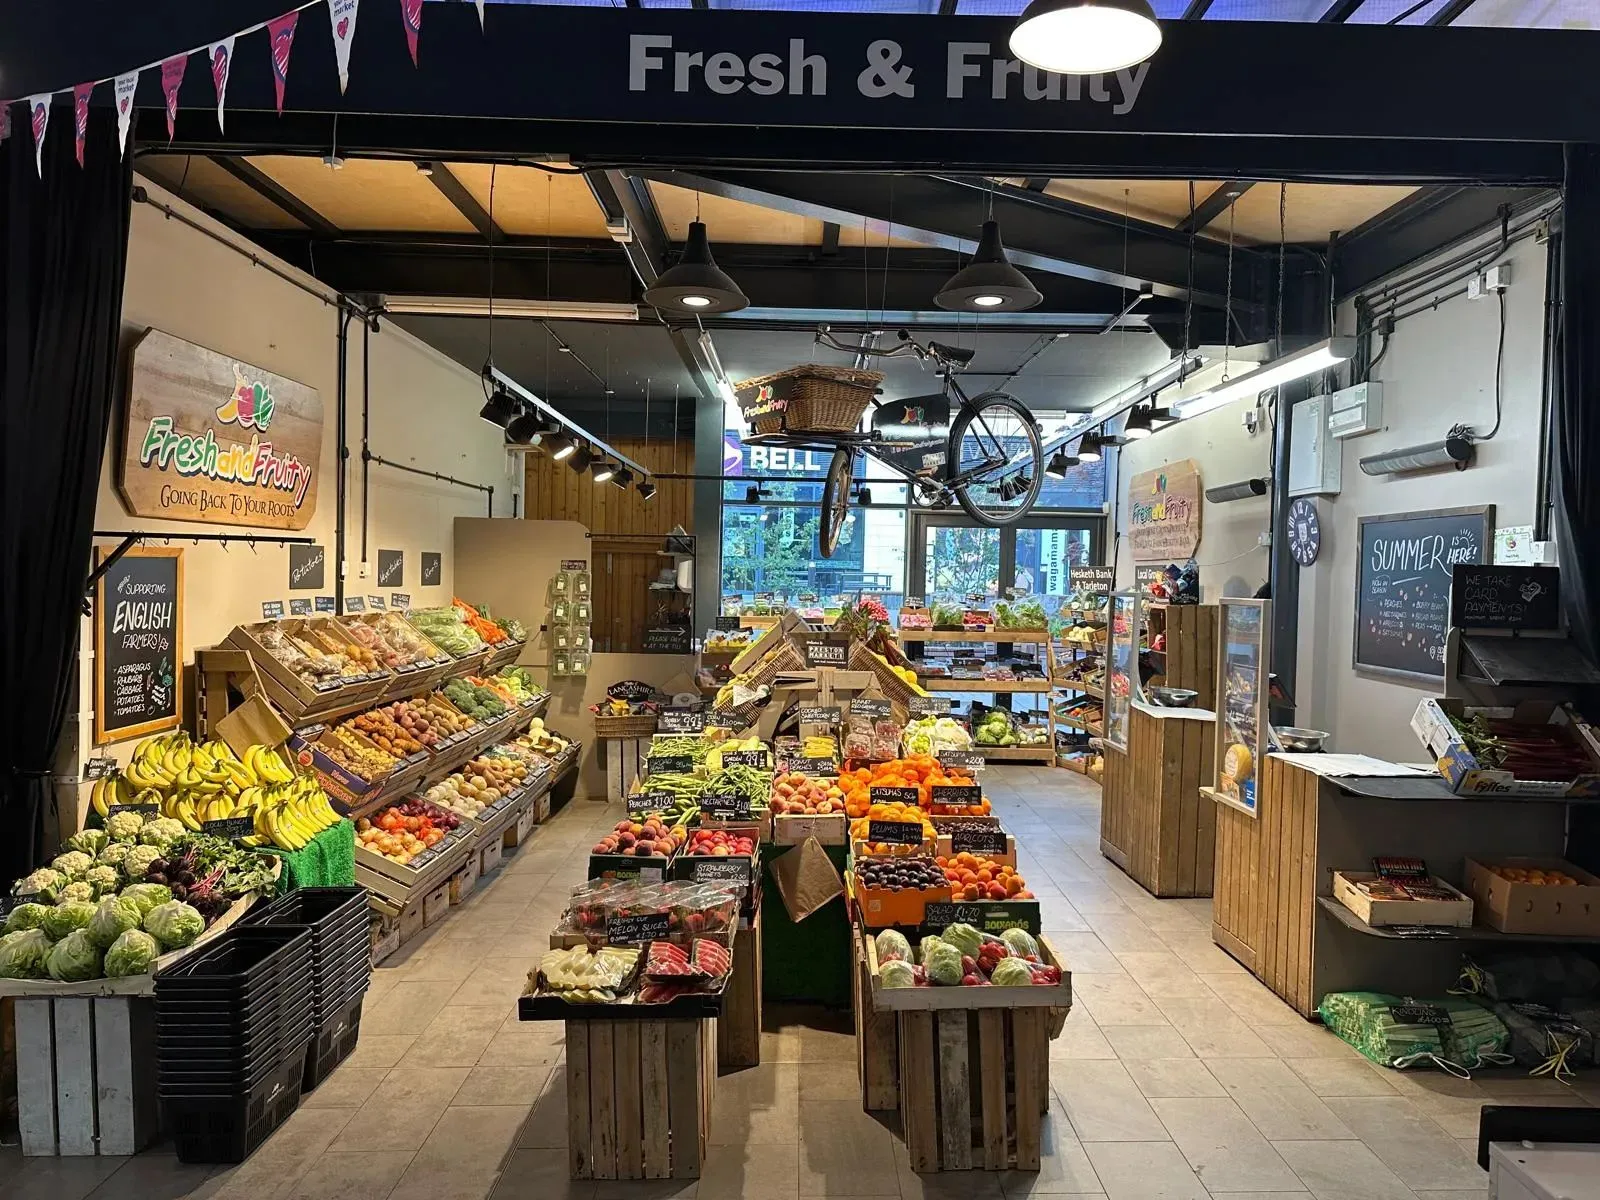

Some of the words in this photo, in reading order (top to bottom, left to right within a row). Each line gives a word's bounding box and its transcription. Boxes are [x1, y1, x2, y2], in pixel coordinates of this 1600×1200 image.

[628, 34, 827, 96] Fresh
[857, 39, 915, 99] &
[750, 445, 821, 470] BELL
[160, 484, 198, 508] GOING
[200, 489, 227, 511] BACK
[230, 492, 244, 515] TO
[244, 494, 267, 516] YOUR
[267, 499, 295, 517] ROOTS
[1050, 529, 1059, 592] wagamam
[1371, 535, 1450, 574] SUMMER
[1451, 536, 1460, 546] IS
[1446, 546, 1478, 565] HERE!
[291, 550, 324, 583] Potatoes
[1070, 568, 1095, 579] Hesketh
[1095, 568, 1113, 579] Bank
[1082, 580, 1108, 591] Tarleton
[1464, 574, 1481, 585] WE
[1484, 575, 1512, 587] TAKE
[125, 583, 166, 595] SUPPORTING
[1464, 587, 1498, 601] CARD
[112, 600, 173, 634] ENGLISH
[117, 662, 151, 675] ASPARAGUS
[117, 674, 143, 687] RHUBARB
[116, 683, 143, 697] CABBAGE
[116, 694, 145, 706] POTATOES
[116, 703, 146, 716] TOMATOES
[871, 787, 902, 797] SATSUMAS
[933, 788, 969, 797] CHERRIES
[1473, 780, 1512, 794] fyffes
[628, 799, 653, 808] PEACHES
[701, 798, 735, 806] NECTARINES
[872, 823, 898, 833] PLUMS
[954, 833, 995, 844] APRICOTS
[697, 864, 741, 874] STRAWBERRY
[928, 904, 954, 915] SALAD
[927, 914, 950, 922] PACKS
[609, 926, 638, 936] MELON
[641, 921, 669, 931] SLICES
[1392, 1006, 1437, 1017] KINDLING
